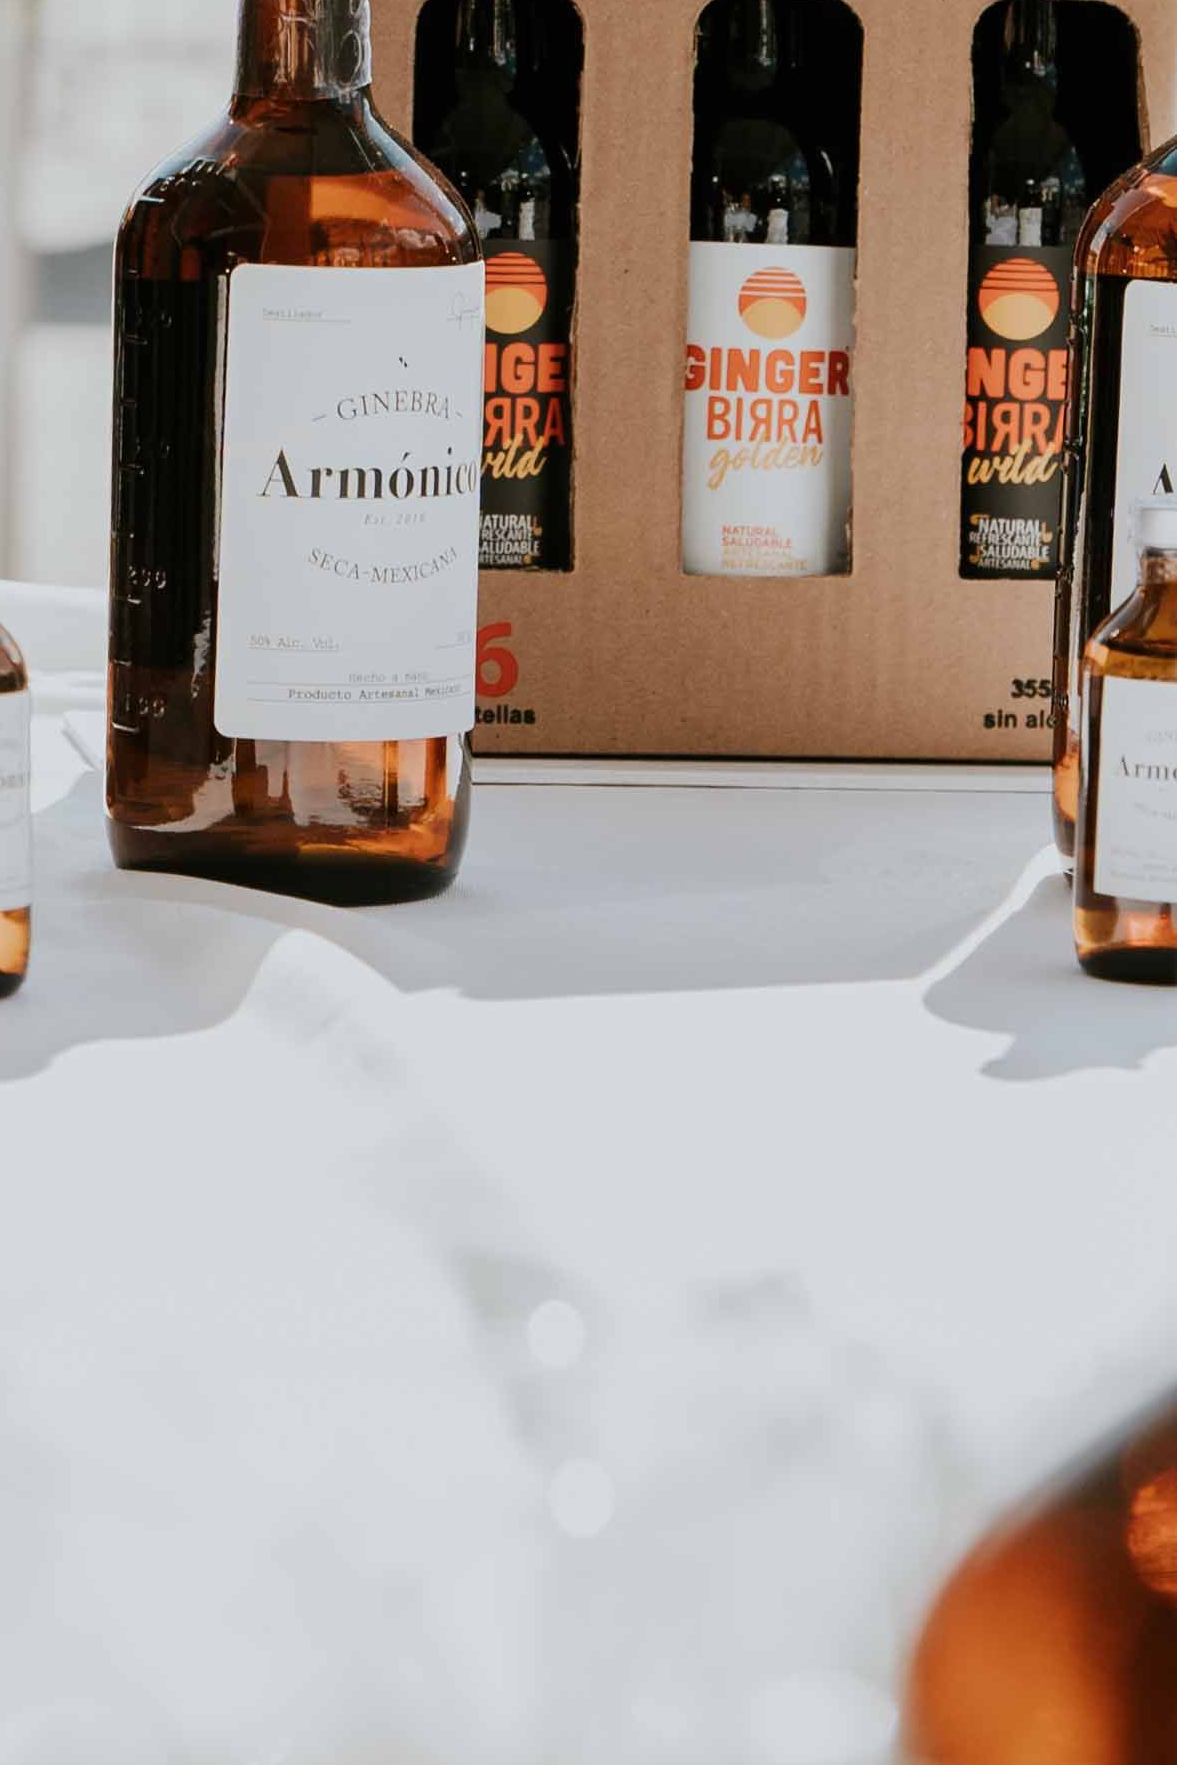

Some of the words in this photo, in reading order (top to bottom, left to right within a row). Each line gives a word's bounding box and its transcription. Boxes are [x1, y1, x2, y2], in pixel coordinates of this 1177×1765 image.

[685, 344, 850, 396] GINGER
[336, 390, 450, 421] GINEBRA
[481, 433, 548, 479] ild
[707, 430, 824, 491] golden
[967, 437, 1059, 485] wild
[257, 446, 477, 500] Armónico
[979, 519, 1040, 534] NATURAL
[479, 540, 541, 556] ALUDABLE
[983, 545, 1050, 559] SALUDABLE
[476, 621, 519, 697] 6
[288, 688, 353, 702] Producto
[359, 687, 420, 701] Artesanal
[1011, 679, 1053, 699] 355
[983, 709, 1017, 729] sin
